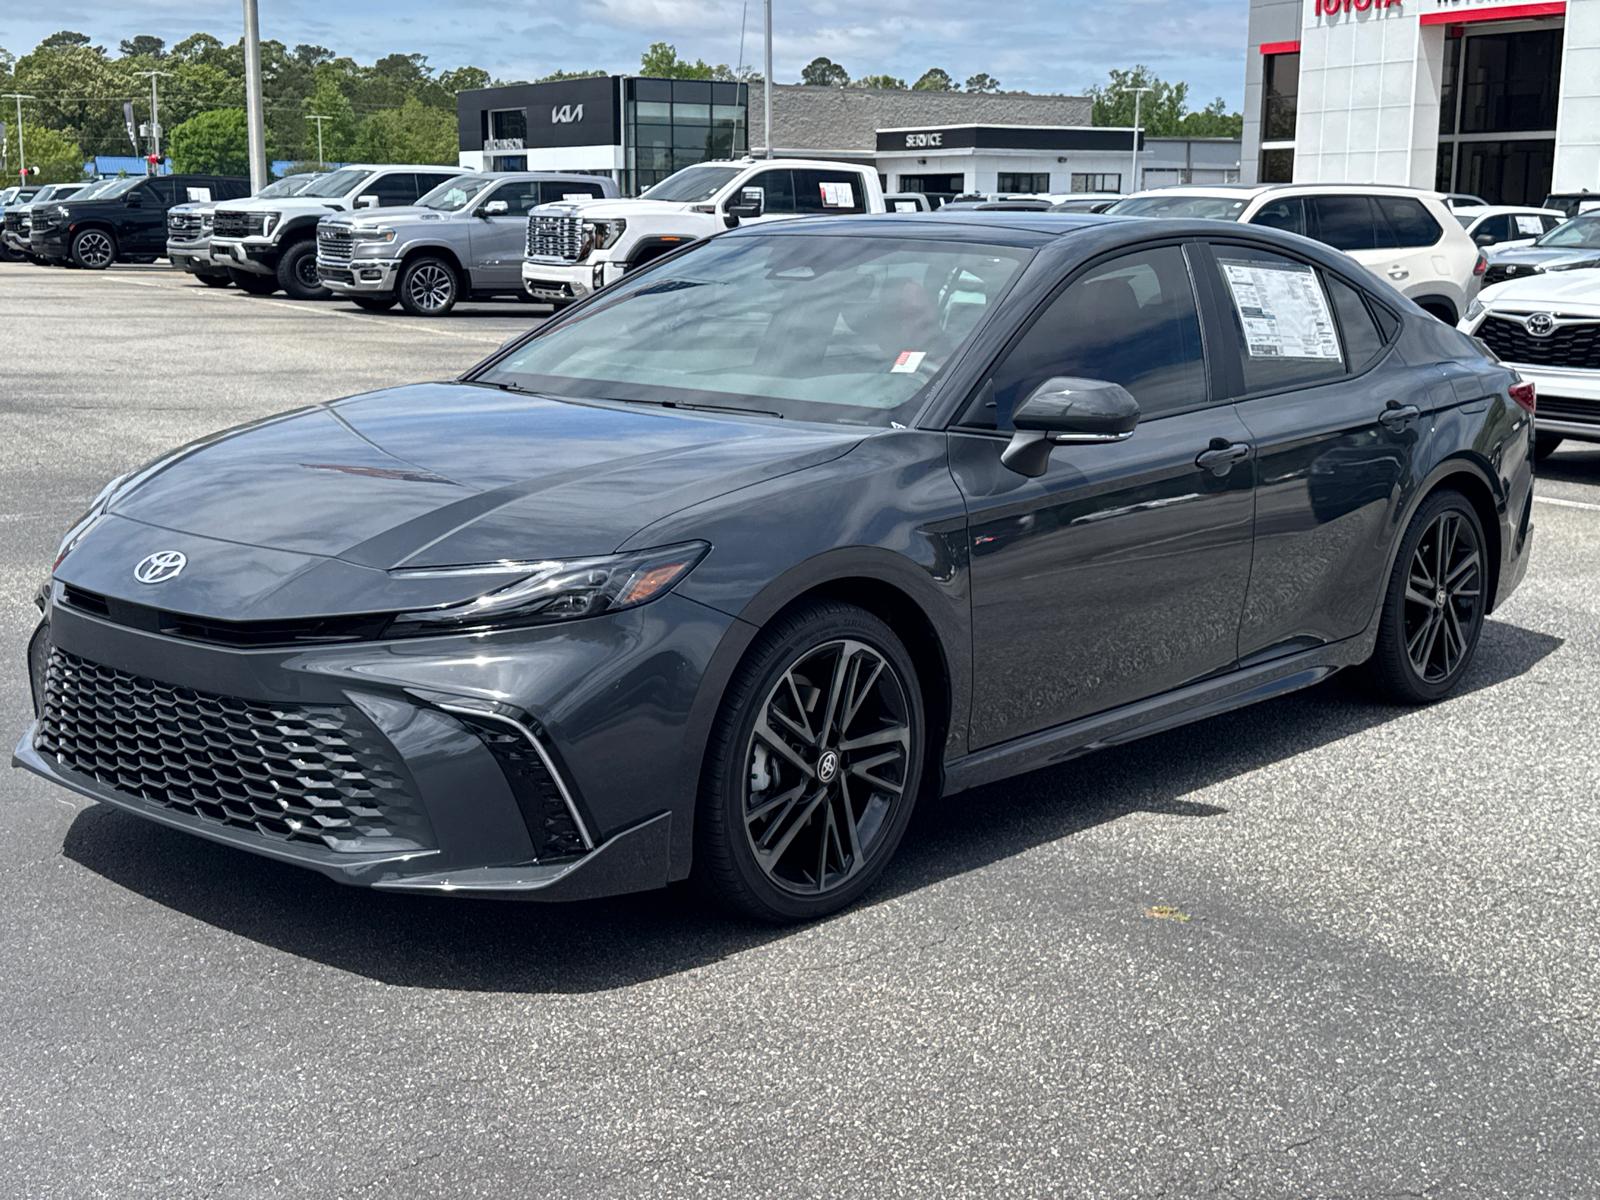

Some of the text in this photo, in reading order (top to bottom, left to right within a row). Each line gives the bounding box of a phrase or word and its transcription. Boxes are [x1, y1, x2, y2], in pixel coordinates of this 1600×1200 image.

[552, 104, 583, 123] KIA
[906, 133, 942, 147] SERVICE
[843, 618, 902, 656] BRIDGESTONE
